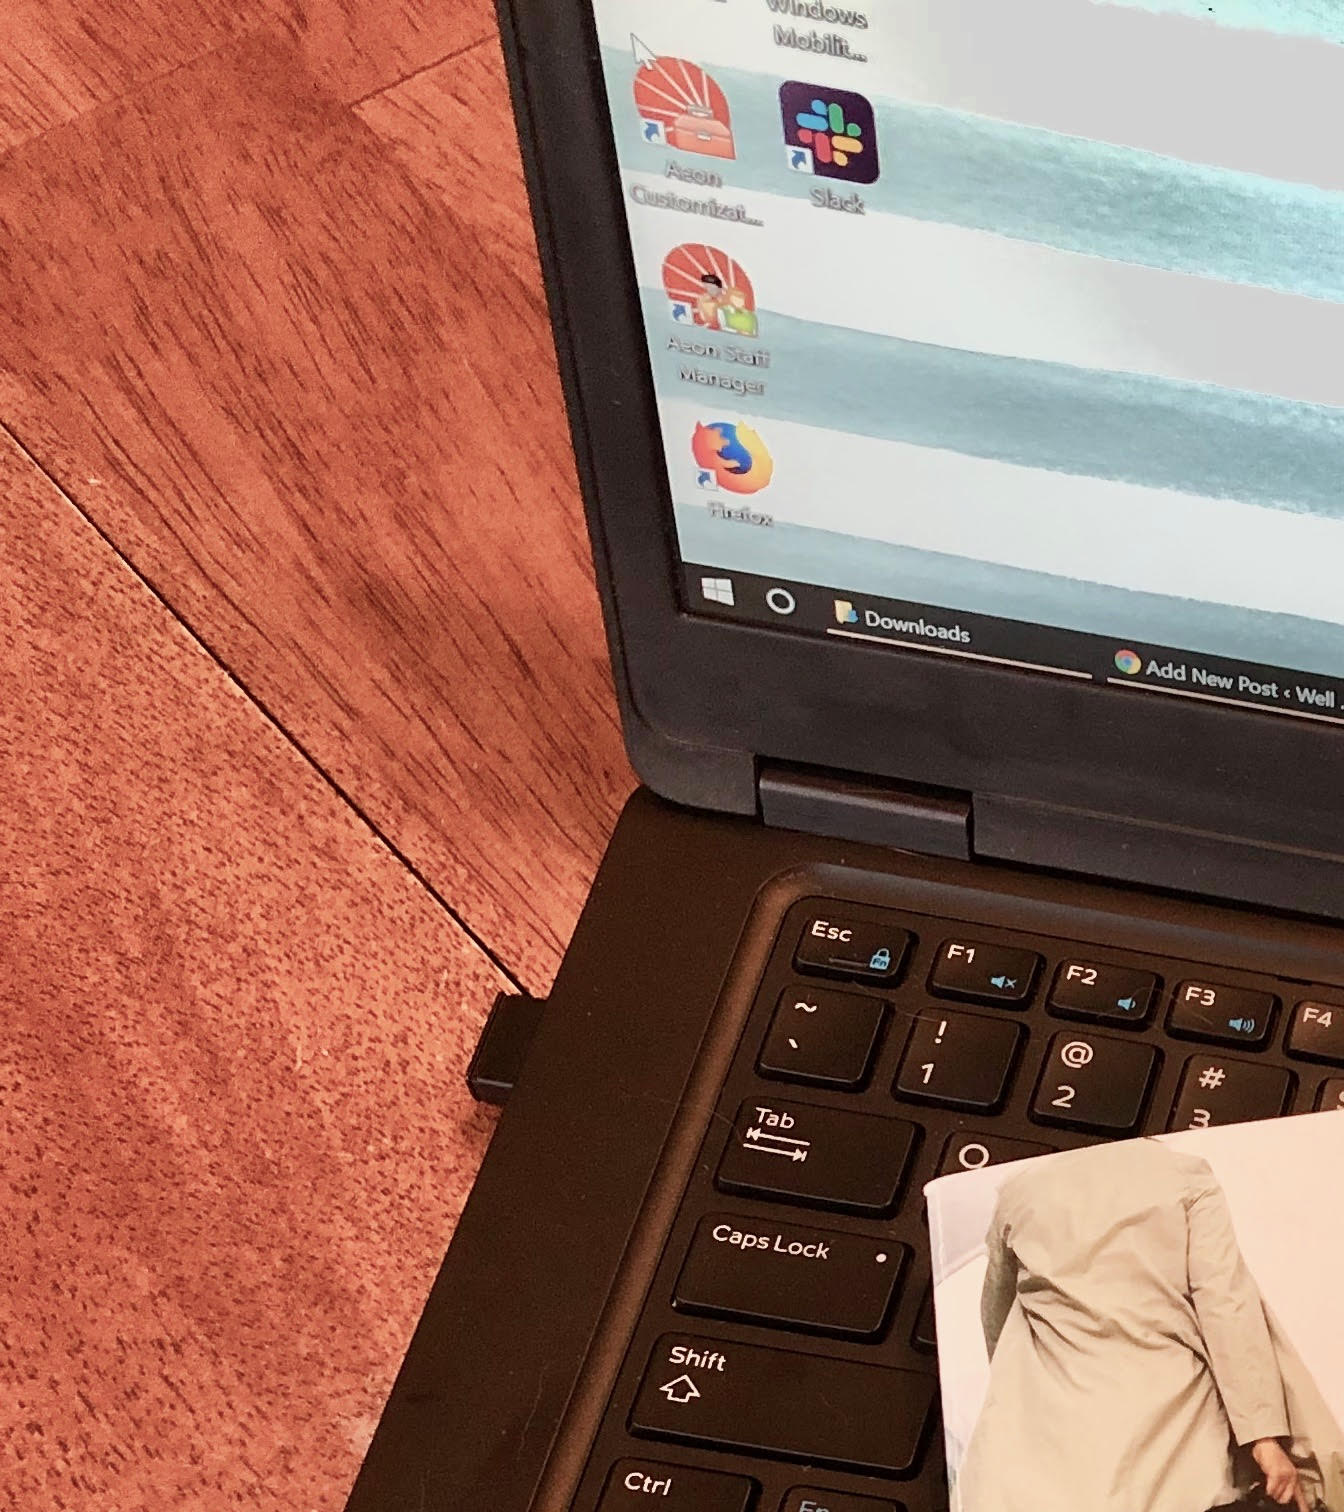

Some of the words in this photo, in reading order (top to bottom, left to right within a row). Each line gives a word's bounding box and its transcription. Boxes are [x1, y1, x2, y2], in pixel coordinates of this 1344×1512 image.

[810, 187, 866, 215] Slack
[667, 336, 720, 359] Aeon
[724, 345, 770, 369] Staff
[679, 366, 765, 397] Manager
[707, 500, 774, 528] Firefox
[864, 610, 971, 644] Downloads
[1146, 660, 1186, 681] Add
[1191, 668, 1233, 690] New
[1238, 676, 1279, 699] Post
[1296, 686, 1335, 708] Well
[812, 920, 853, 943] Esc
[947, 944, 976, 964] F1
[1066, 965, 1098, 987] F2
[1185, 987, 1217, 1006] F3
[1302, 1007, 1332, 1028] F4
[934, 1020, 948, 1045] !
[1061, 1041, 1094, 1069] @
[920, 1062, 935, 1085] 1
[1199, 1067, 1225, 1089] #
[1052, 1085, 1076, 1109] 2
[755, 1107, 795, 1130] Tab
[1188, 1109, 1211, 1129] 3
[712, 1225, 770, 1251] Caps
[773, 1235, 830, 1260] Lock
[669, 1346, 727, 1372] Shift
[624, 1472, 673, 1497] Ctrl
